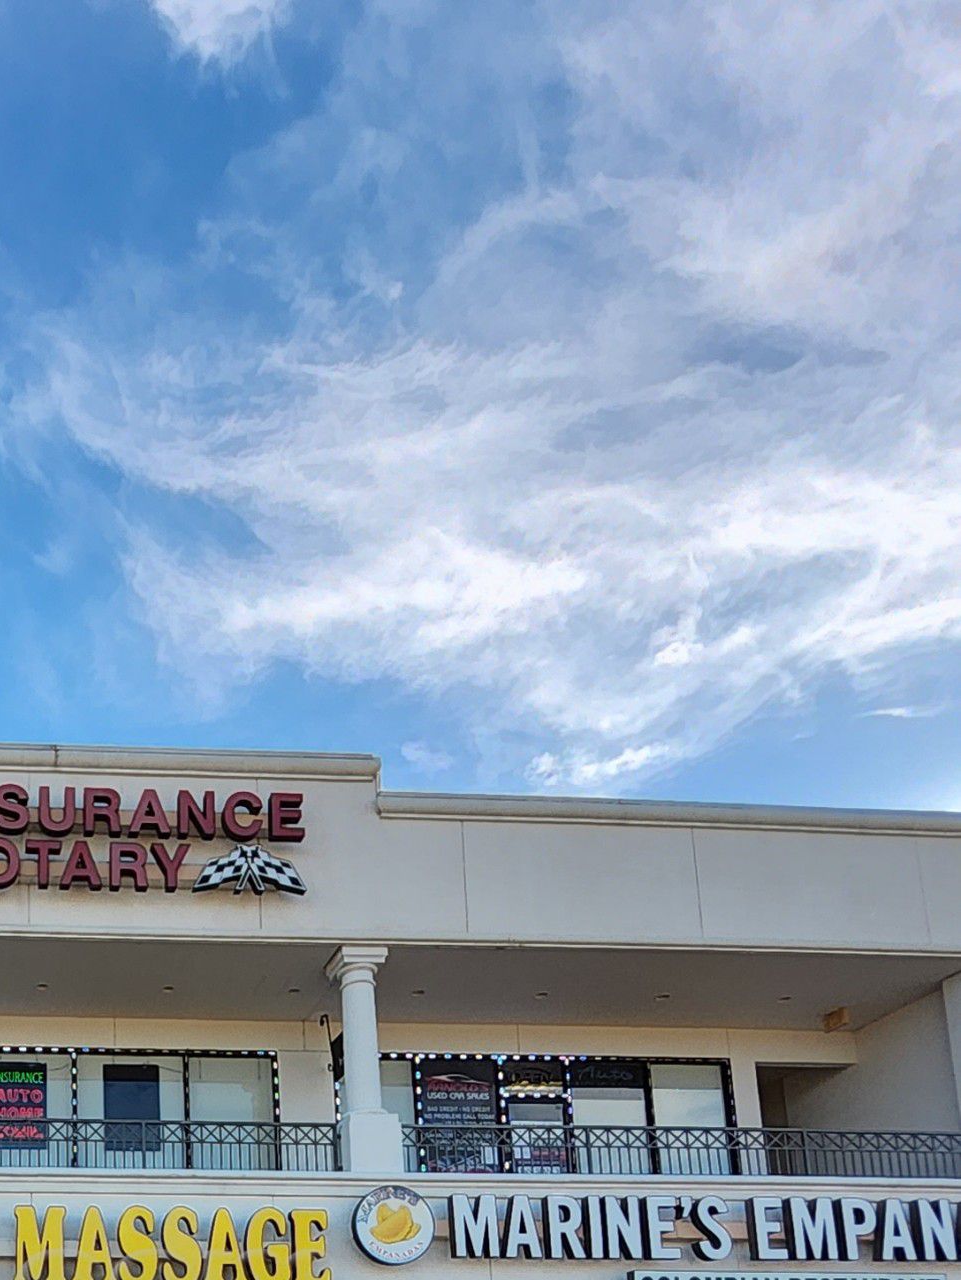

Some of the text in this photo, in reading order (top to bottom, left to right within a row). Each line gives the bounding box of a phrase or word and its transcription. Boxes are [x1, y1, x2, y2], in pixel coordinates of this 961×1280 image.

[427, 1092, 447, 1100] USED
[466, 1092, 490, 1100] SALES
[450, 1193, 959, 1262] MARINE'S EMPAN
